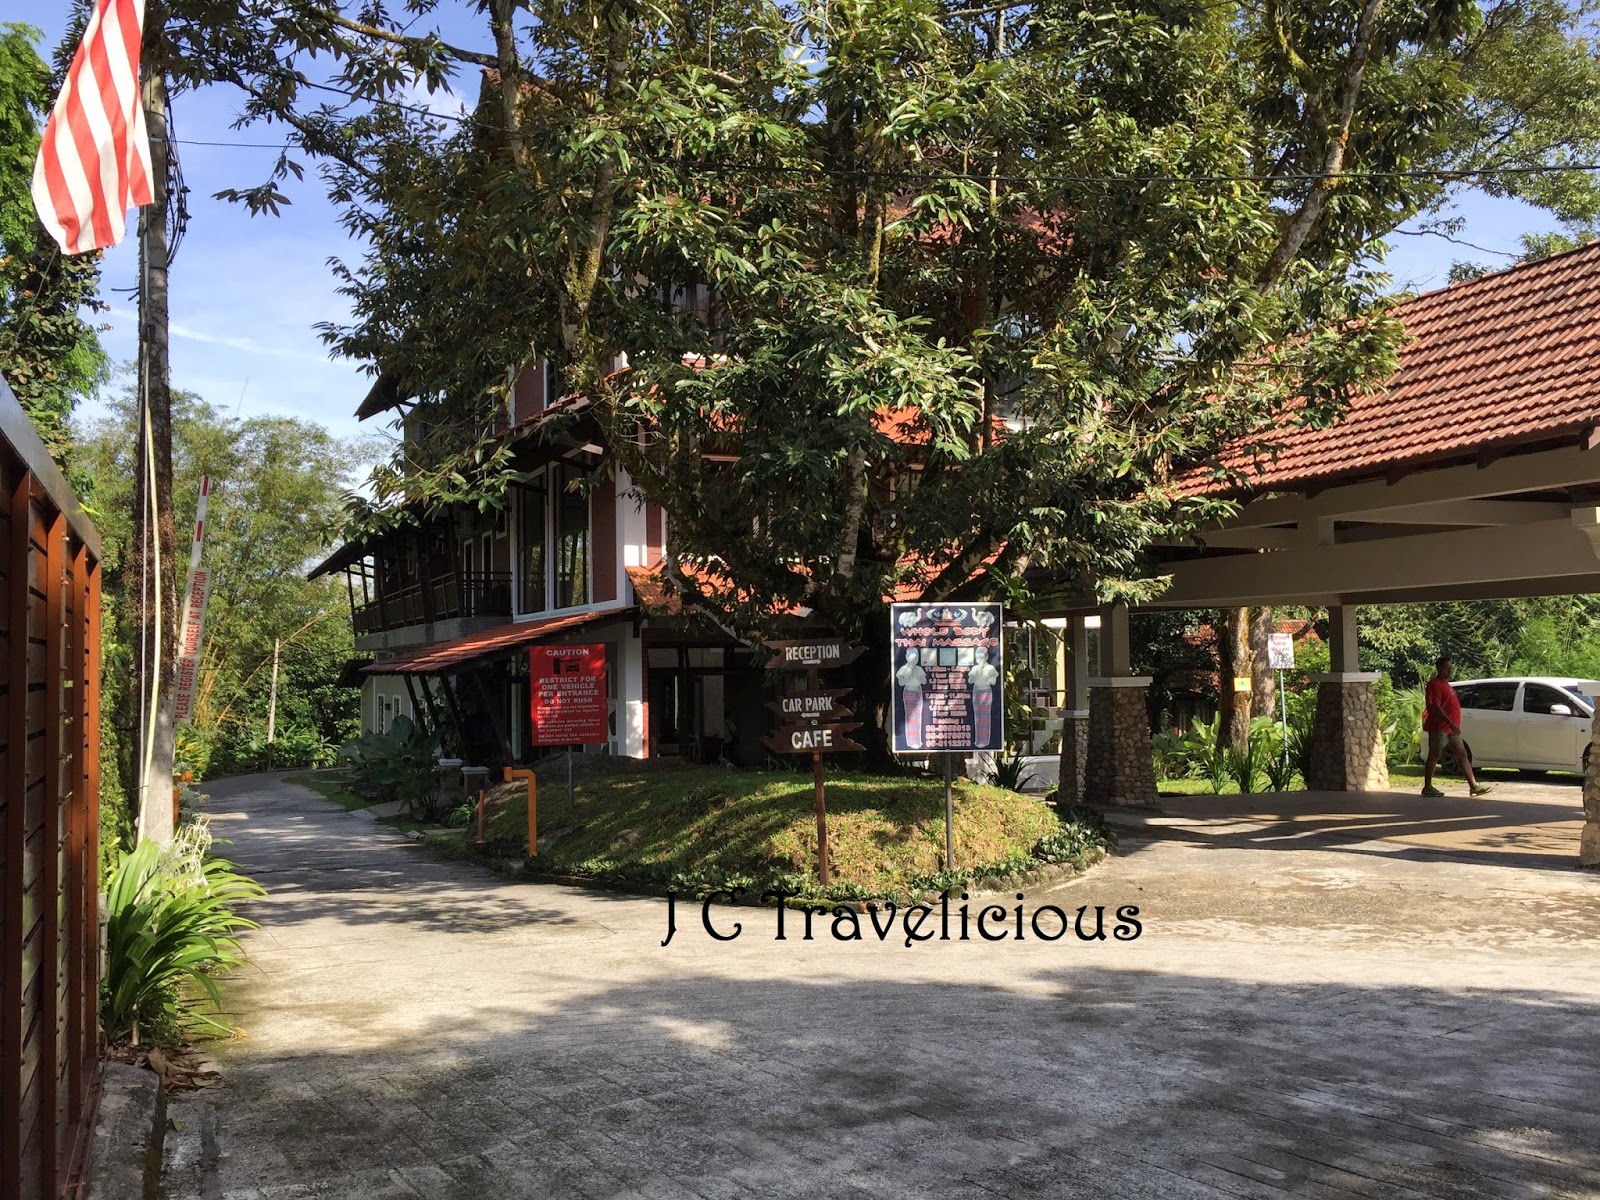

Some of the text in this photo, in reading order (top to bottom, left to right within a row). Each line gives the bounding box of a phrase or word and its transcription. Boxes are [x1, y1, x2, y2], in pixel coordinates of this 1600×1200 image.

[900, 626, 990, 638] WHOLE BODY
[175, 571, 207, 719] PLEASE REGISTER YOURSELF AT RECEPTION
[895, 637, 999, 648] THAI MASSAGE
[546, 648, 590, 656] CAUTION
[785, 644, 840, 661] RECEPTION
[539, 676, 578, 684] RESTRICT
[561, 682, 595, 690] VEHICLE
[782, 696, 833, 712] CAR PARK
[791, 729, 833, 749] CAFE
